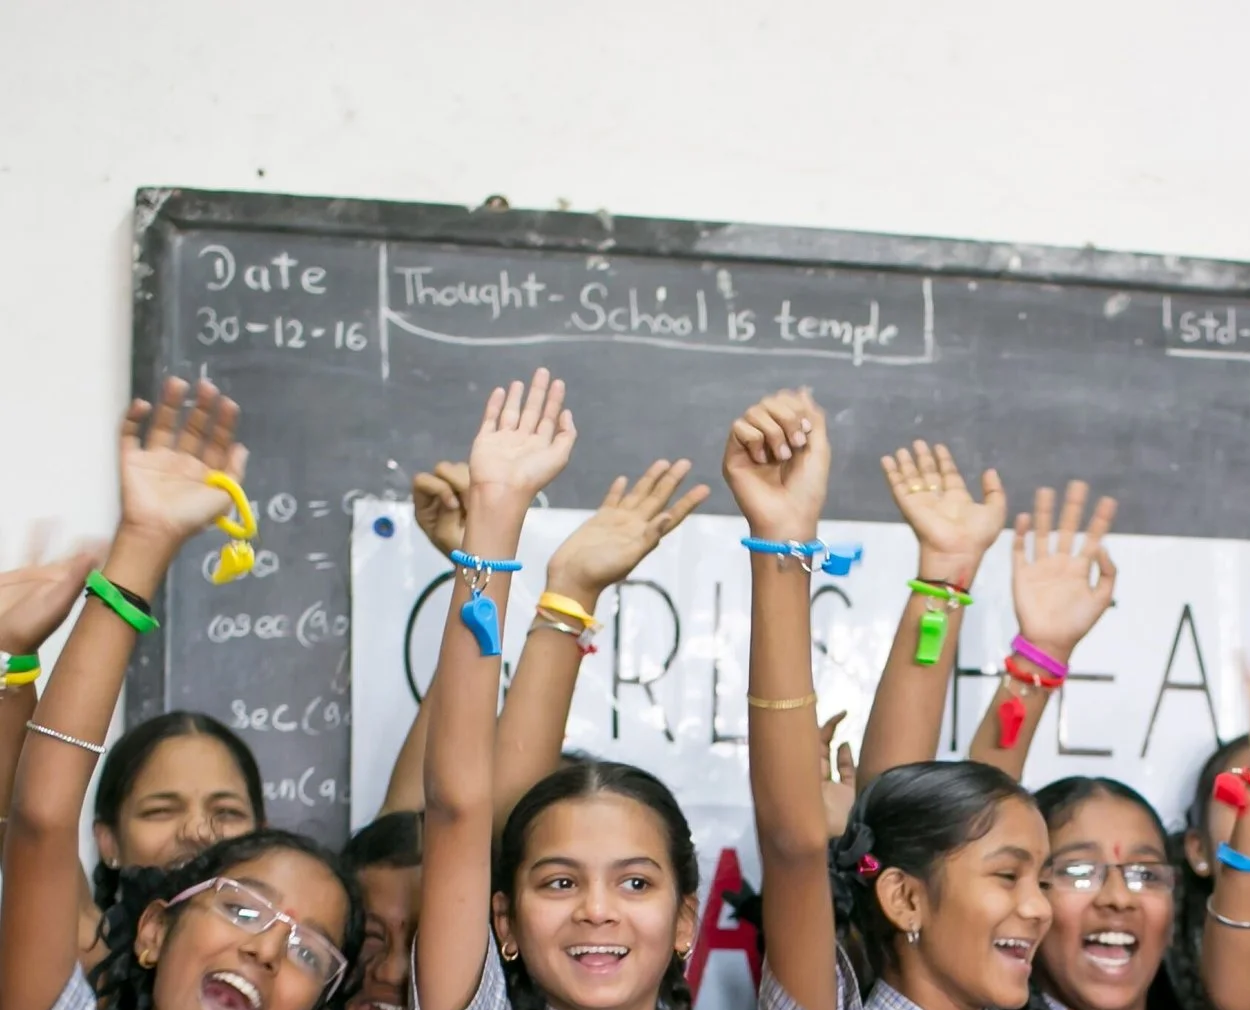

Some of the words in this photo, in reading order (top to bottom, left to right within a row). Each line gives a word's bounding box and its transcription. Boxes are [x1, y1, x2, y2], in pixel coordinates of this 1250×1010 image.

[197, 244, 328, 295] Date
[569, 281, 708, 336] School
[773, 298, 899, 367] temple
